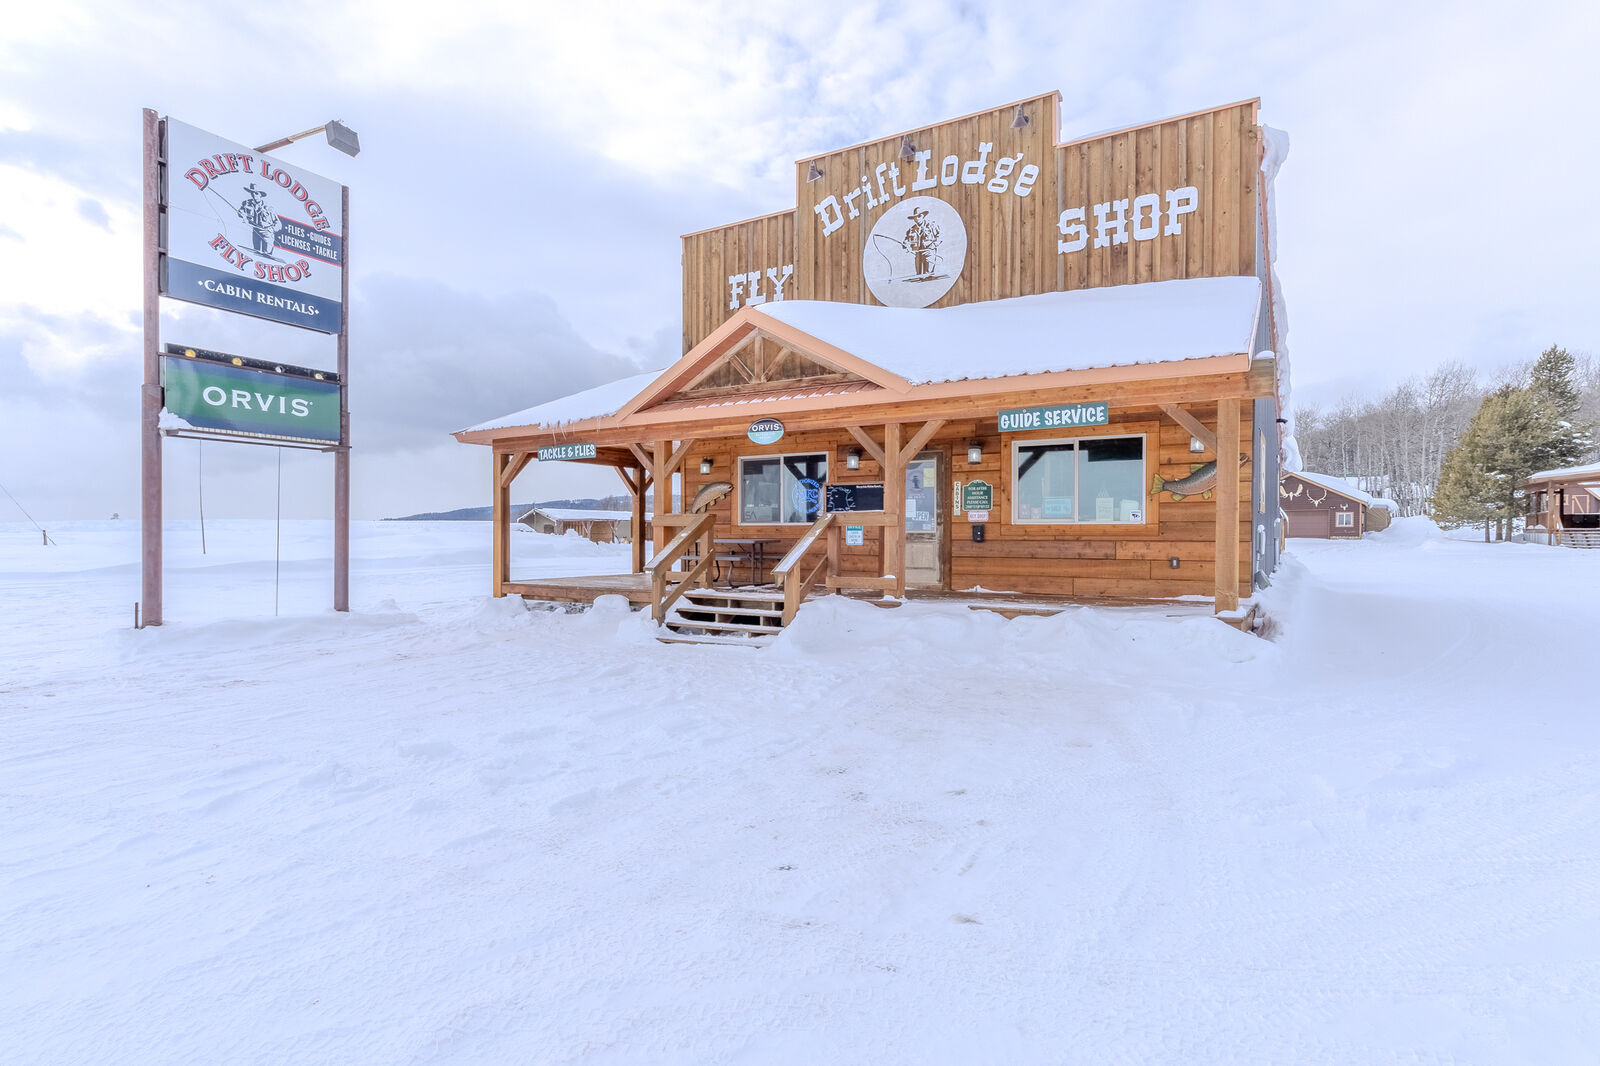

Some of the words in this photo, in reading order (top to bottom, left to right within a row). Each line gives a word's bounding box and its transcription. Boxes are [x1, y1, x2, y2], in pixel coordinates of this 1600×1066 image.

[184, 153, 253, 190] DRIFT
[260, 159, 330, 231] LODGE
[814, 162, 906, 237] Drift
[912, 142, 1040, 197] Lodge
[288, 224, 305, 237] FLIES
[309, 231, 332, 246] GUIDES
[1056, 186, 1199, 254] SHOP
[208, 233, 253, 271] FLY
[254, 259, 312, 283] SHOP
[281, 234, 311, 252] LICENSES
[315, 245, 337, 260] TACKLE
[204, 280, 252, 300] CABIN
[256, 292, 315, 316] RENTALS
[728, 264, 793, 310] FLY
[203, 386, 310, 417] ORVIS
[1000, 411, 1041, 429] GUIDE
[1044, 406, 1105, 426] SERVICE
[751, 423, 780, 432] ORVIS
[538, 447, 566, 460] TACKLE
[567, 446, 574, 458] &
[574, 444, 595, 457] FLIES
